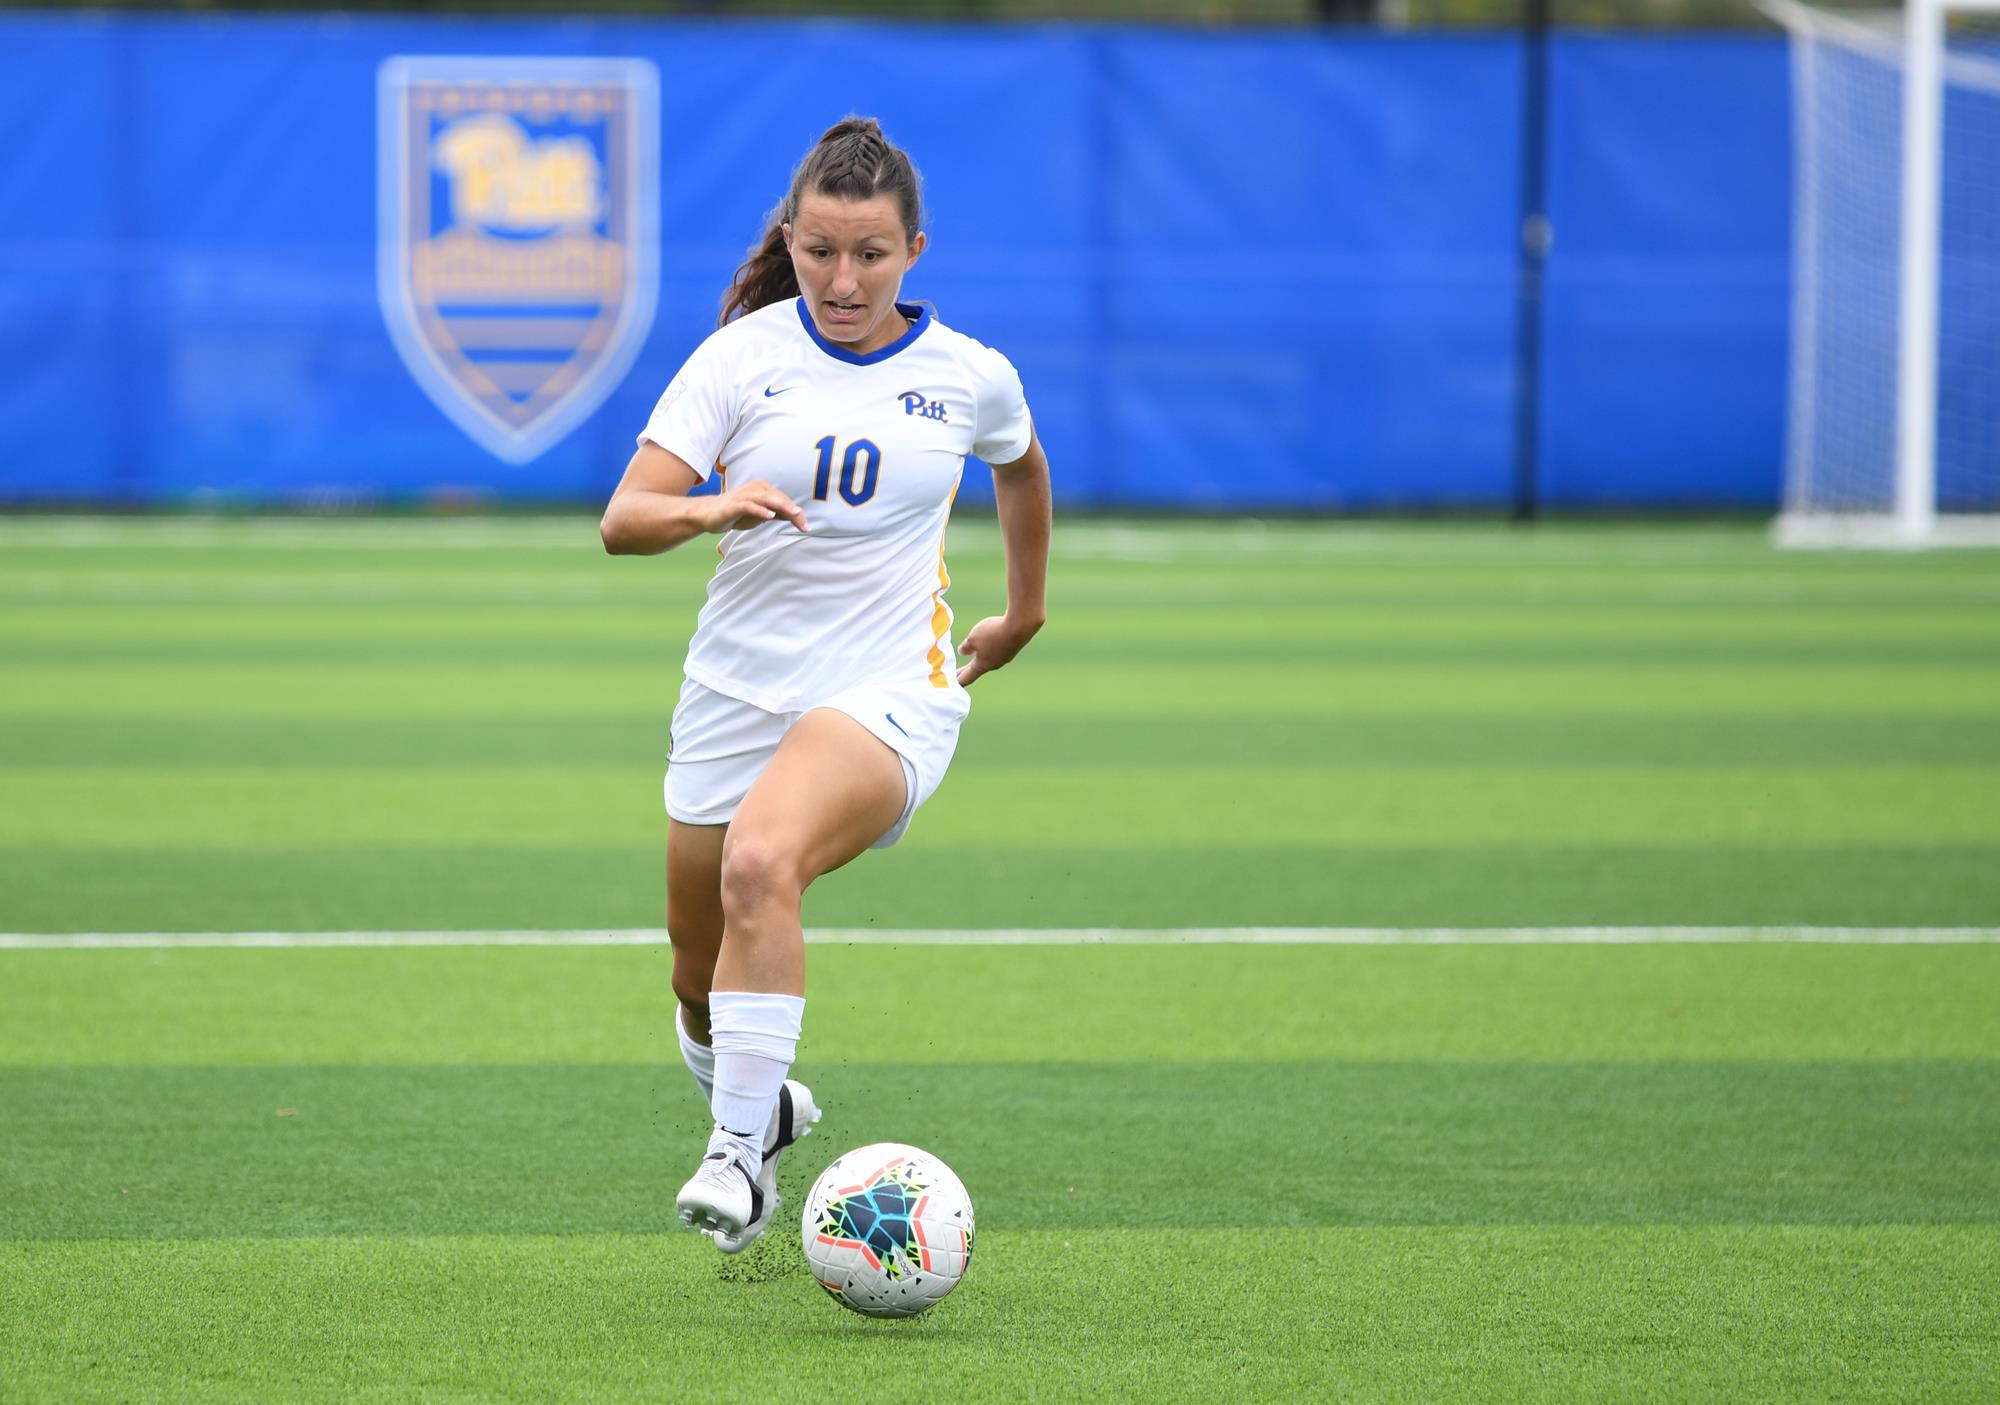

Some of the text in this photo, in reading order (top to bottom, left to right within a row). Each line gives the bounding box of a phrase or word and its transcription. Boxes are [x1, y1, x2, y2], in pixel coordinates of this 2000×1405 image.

[434, 113, 603, 226] Pitt
[897, 390, 949, 424] Pitt
[812, 434, 884, 508] 10
